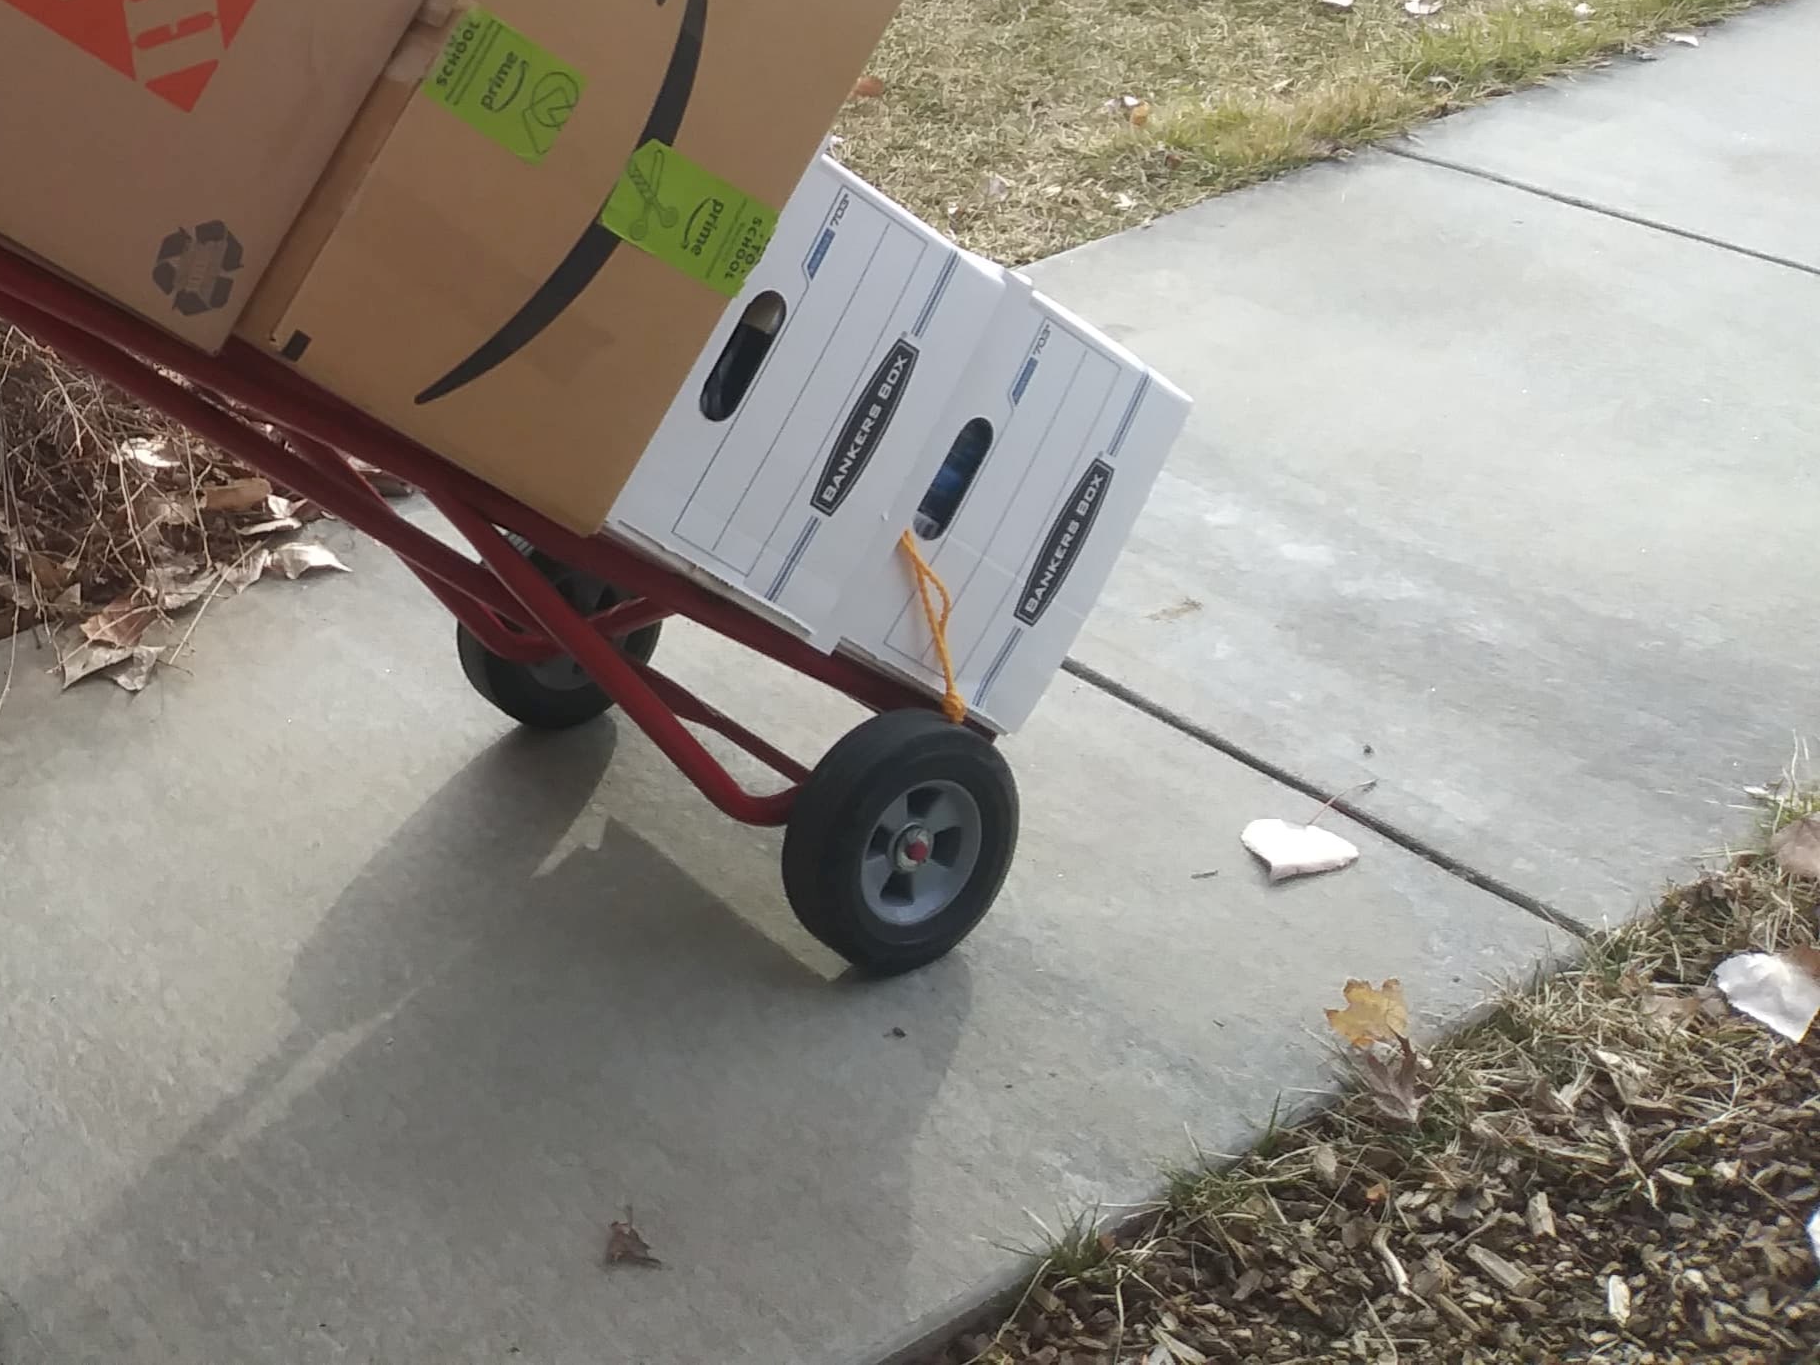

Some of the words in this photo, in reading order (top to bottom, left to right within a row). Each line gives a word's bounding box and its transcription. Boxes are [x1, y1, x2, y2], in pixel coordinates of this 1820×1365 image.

[436, 21, 481, 86] SCHOOL
[480, 51, 518, 110] prime
[691, 198, 724, 256] prime
[724, 216, 762, 279] SCHOOL
[744, 244, 761, 265] TO
[821, 403, 882, 502] BANKERS
[878, 354, 908, 399] BOX
[1024, 520, 1080, 613] BANKERS
[1076, 473, 1104, 516] BOX
